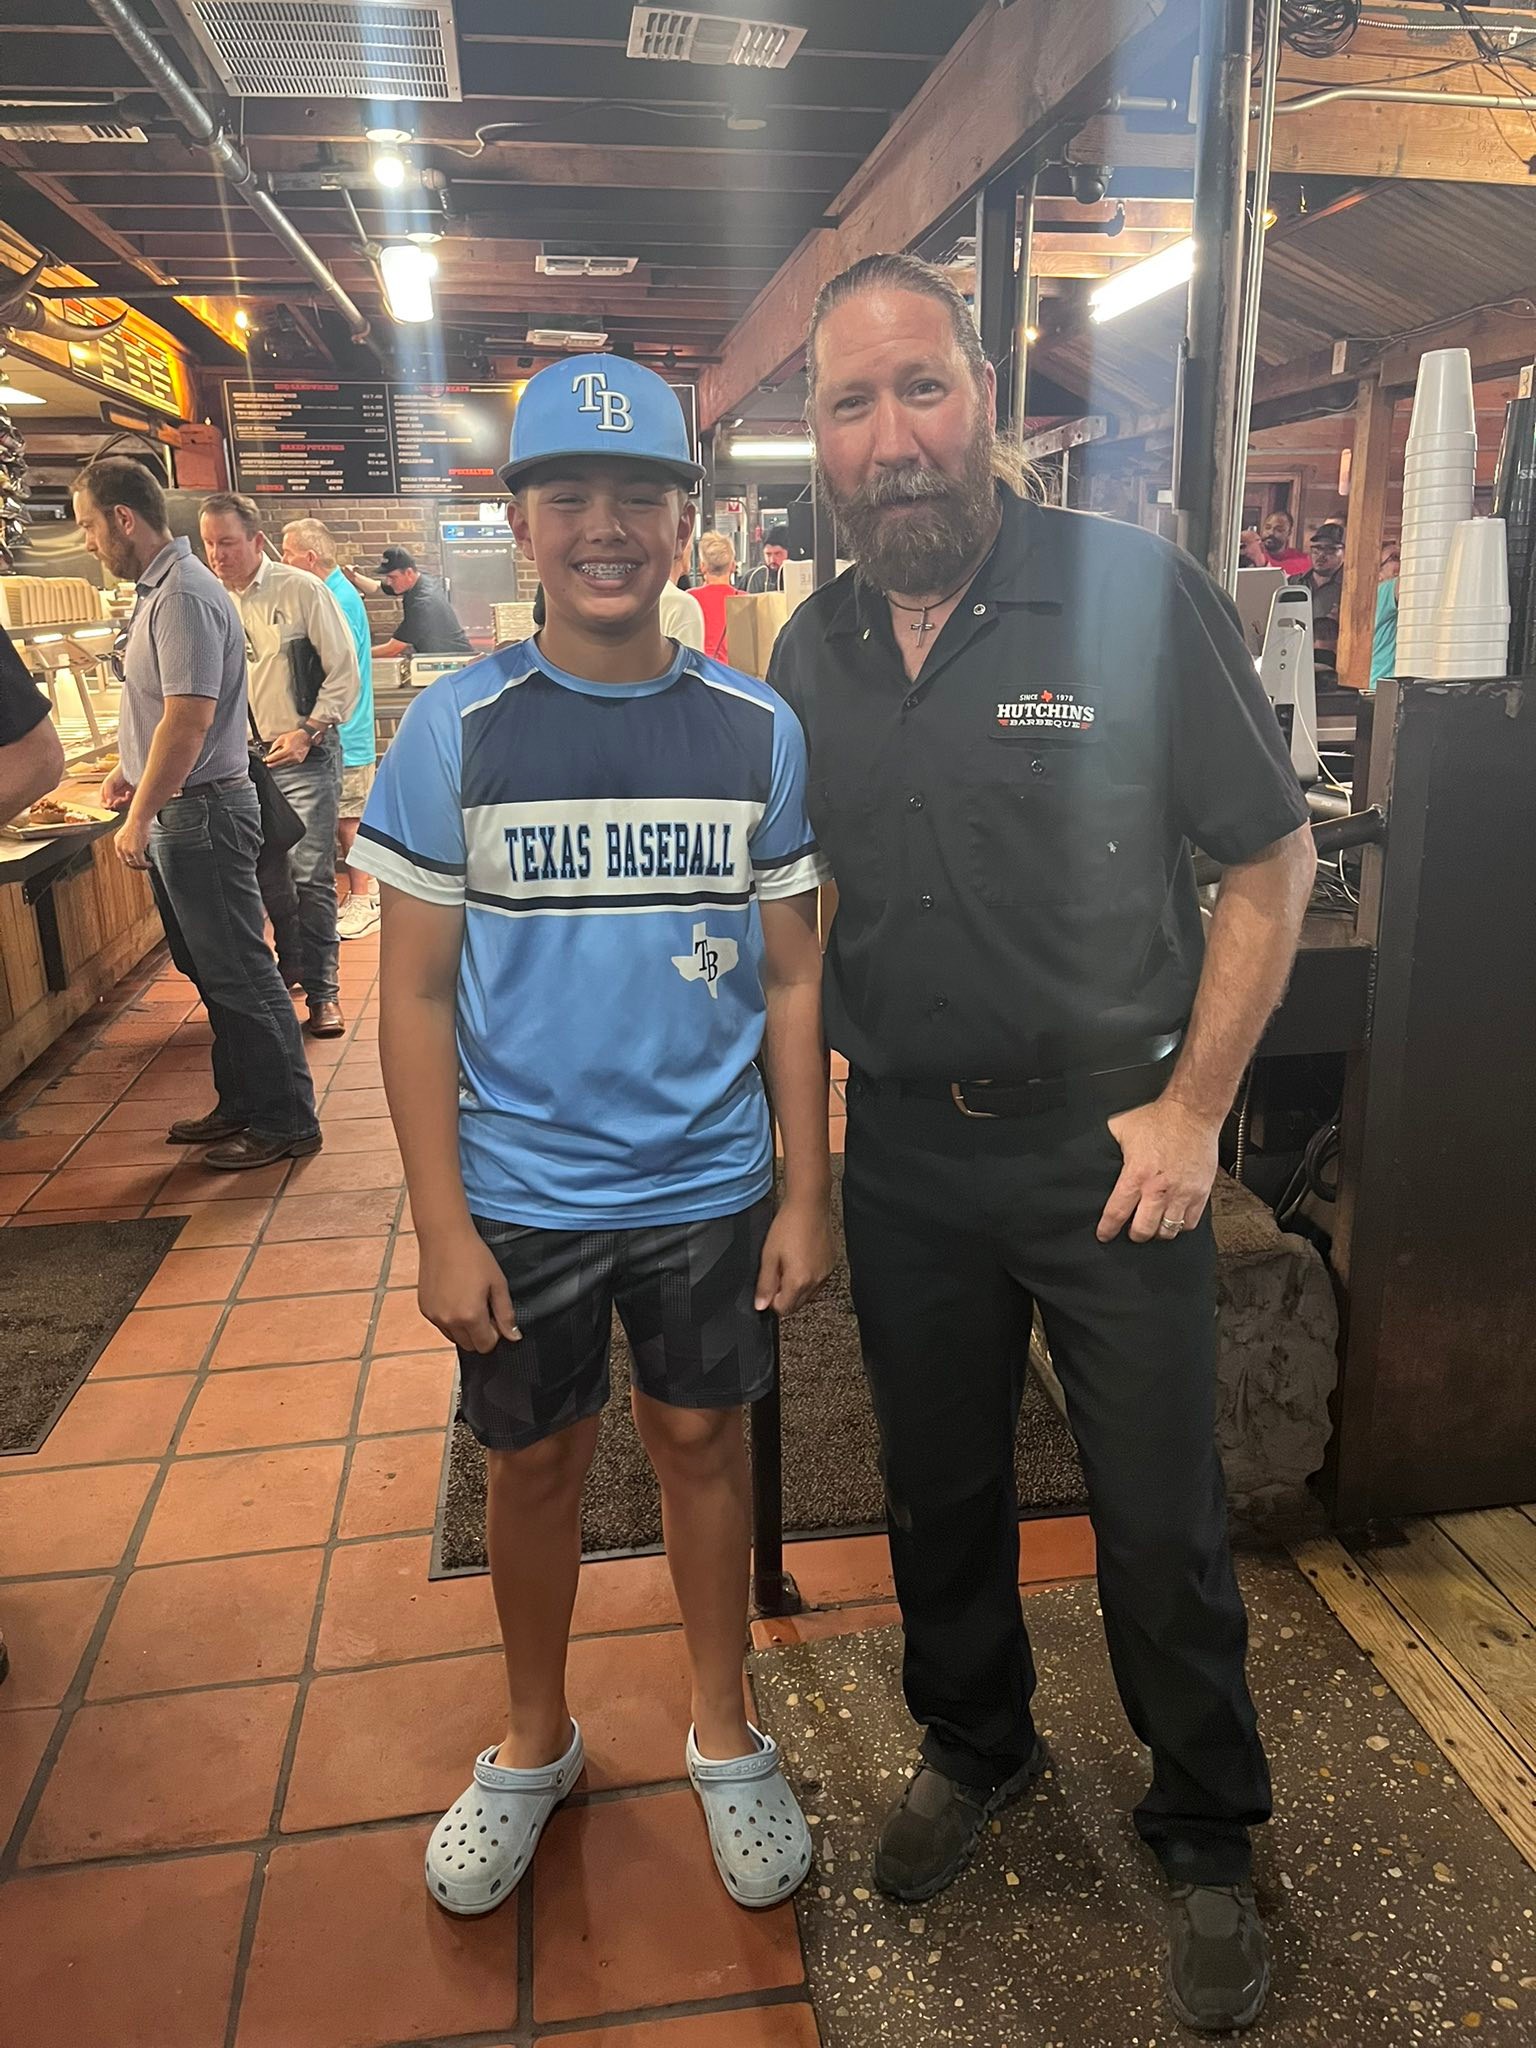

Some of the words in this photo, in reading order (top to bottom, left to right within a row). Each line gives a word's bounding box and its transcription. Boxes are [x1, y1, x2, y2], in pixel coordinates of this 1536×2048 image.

[572, 372, 634, 433] TB
[996, 703, 1095, 722] HUTCHINS
[1019, 693, 1038, 701] SINCE
[1056, 694, 1074, 702] 1978
[1009, 719, 1080, 729] BARBEQUE
[504, 823, 591, 882] TEXAS
[606, 822, 735, 878] BASEBALL
[695, 939, 719, 982] TB
